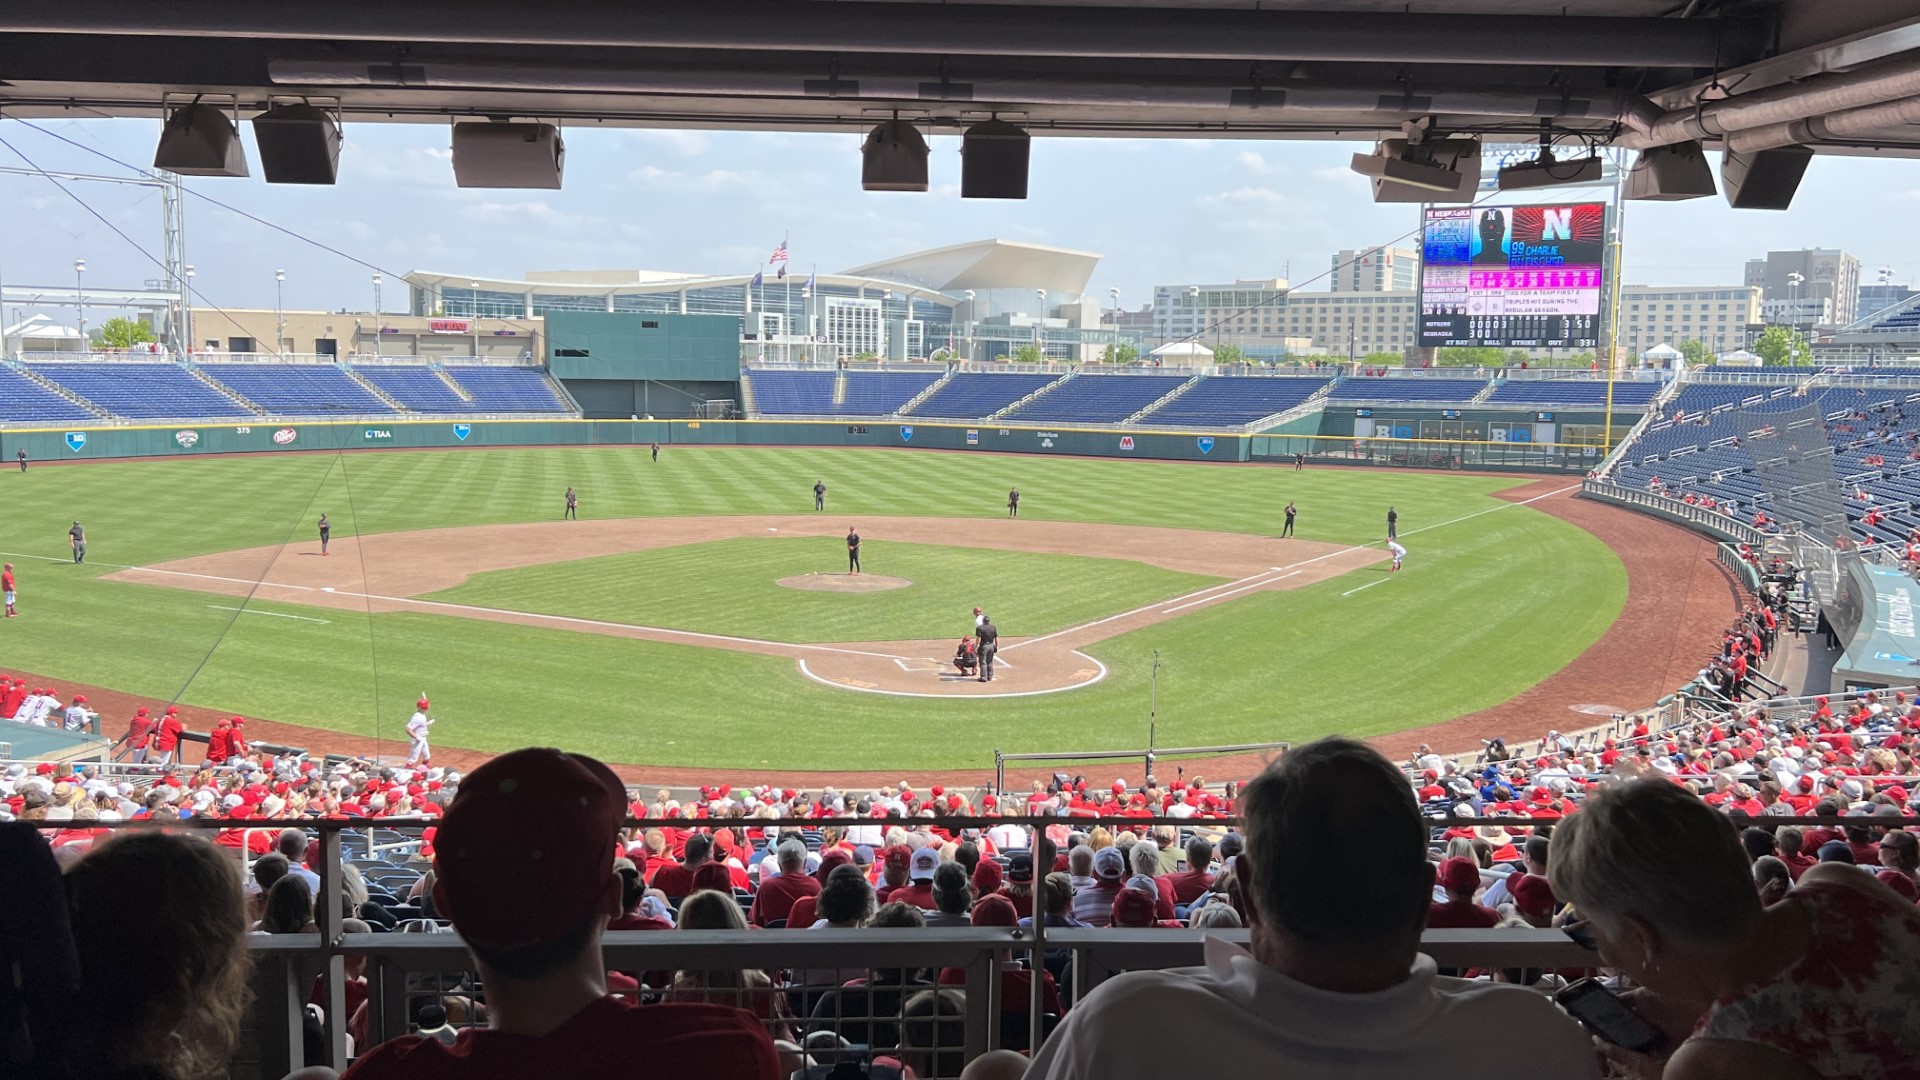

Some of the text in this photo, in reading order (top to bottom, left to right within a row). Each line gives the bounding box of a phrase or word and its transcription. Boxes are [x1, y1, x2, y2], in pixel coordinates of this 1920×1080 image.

[1434, 209, 1471, 218] NEBRASKA
[1486, 211, 1496, 220] N
[1542, 208, 1572, 240] N
[1511, 241, 1559, 255] 99 CHARLIE
[1470, 321, 1475, 329] 0
[1478, 321, 1483, 329] 0
[1486, 321, 1491, 329] 0
[1493, 321, 1499, 329] 0
[1502, 321, 1507, 329] 3
[1564, 320, 1570, 328] 3
[1576, 320, 1582, 328] 5
[1585, 320, 1590, 328] 0
[1469, 330, 1475, 338] 3
[1477, 330, 1483, 338] 0
[1485, 330, 1491, 338] 0
[1564, 330, 1569, 338] 3
[236, 426, 251, 434] 375
[374, 430, 391, 438] TIAA
